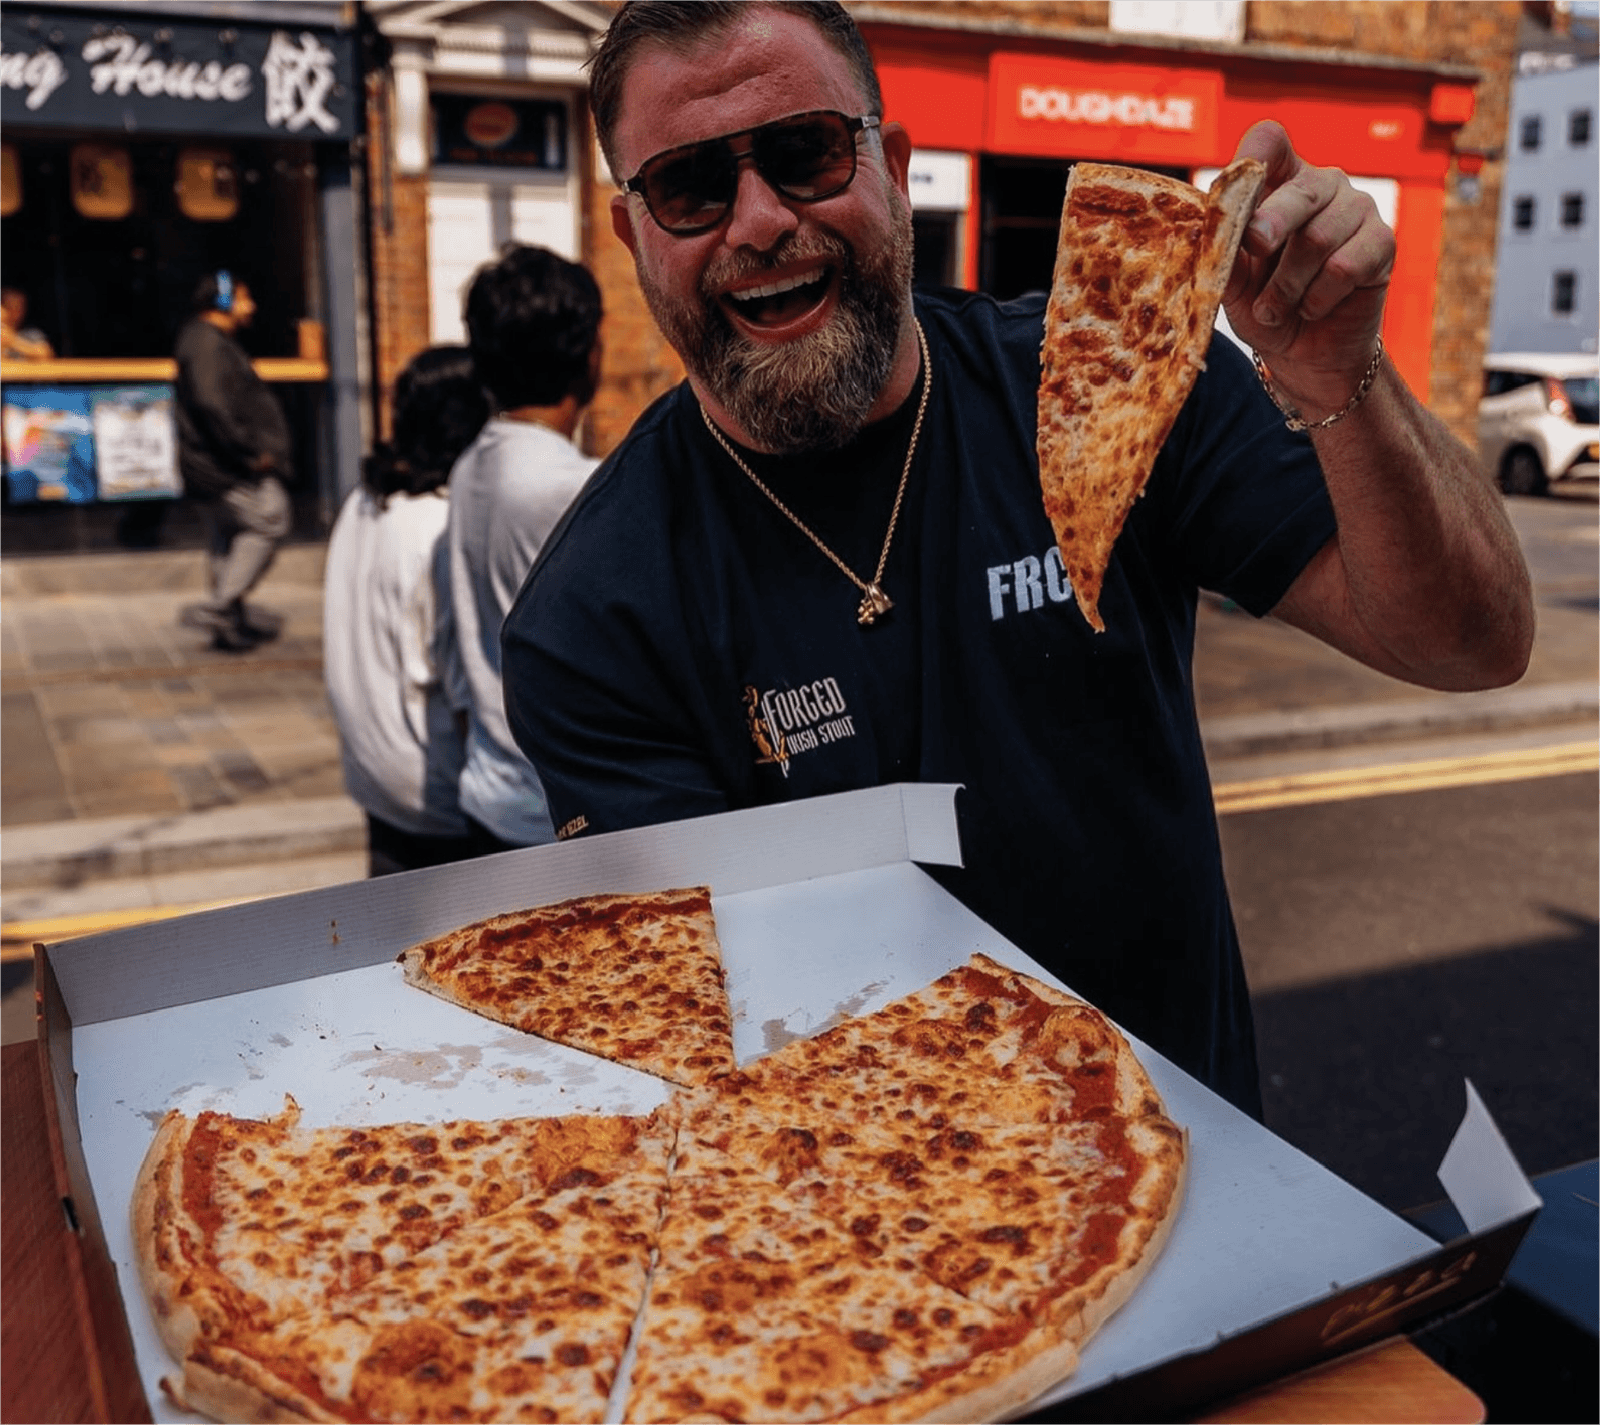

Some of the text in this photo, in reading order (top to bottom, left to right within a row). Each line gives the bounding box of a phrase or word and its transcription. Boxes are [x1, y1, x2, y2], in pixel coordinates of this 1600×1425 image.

[82, 34, 251, 101] House
[987, 546, 1072, 620] FRC
[762, 677, 846, 752] FORGED
[786, 715, 856, 755] IRISH STOUT
